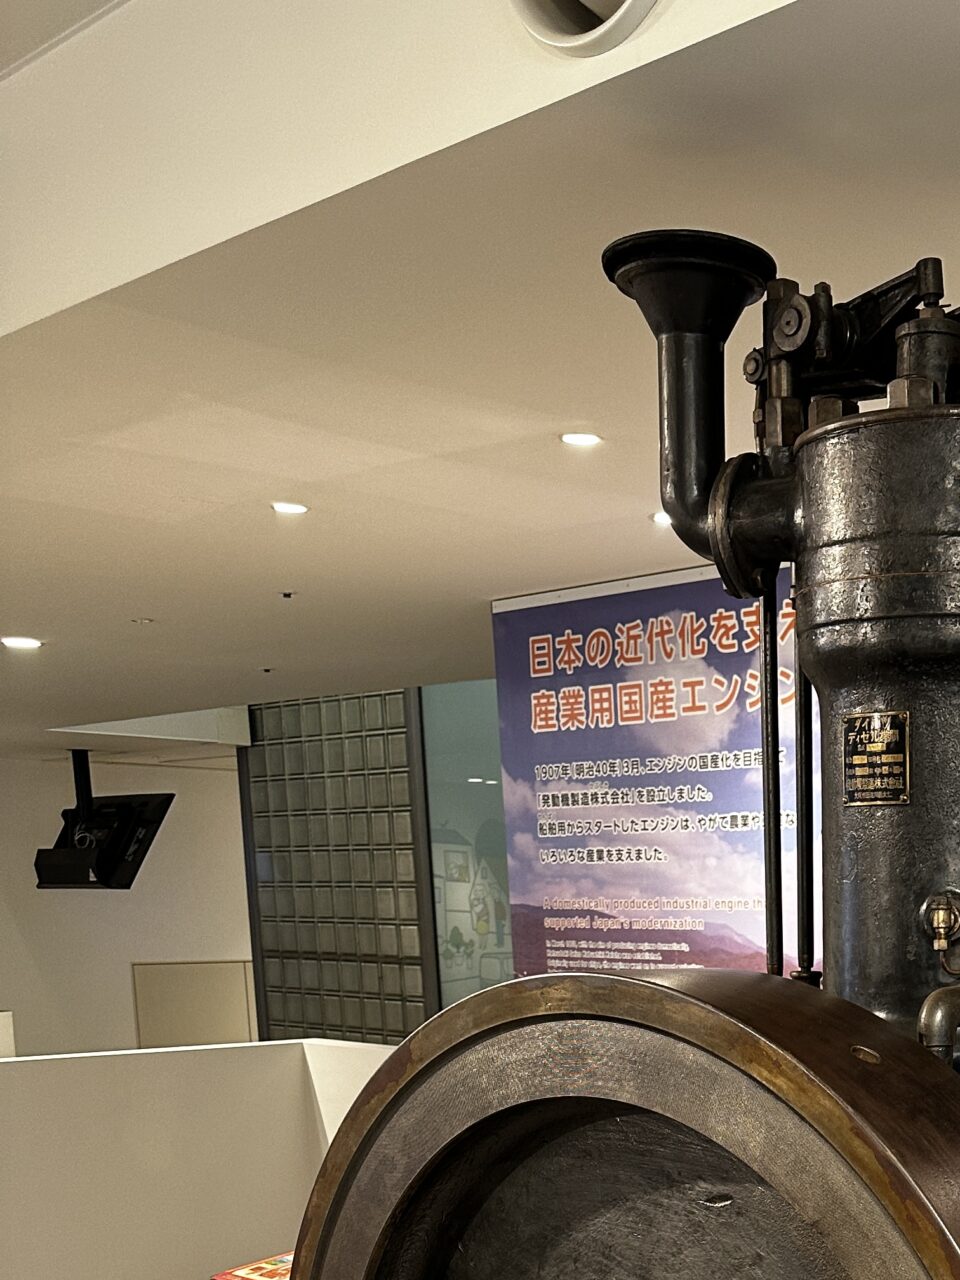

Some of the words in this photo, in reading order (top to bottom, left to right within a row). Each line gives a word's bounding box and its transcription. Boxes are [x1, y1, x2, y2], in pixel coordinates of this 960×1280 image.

[540, 847, 669, 864] いろいろな産業を支えました。
[543, 897, 551, 909] A
[553, 896, 610, 913] domestically
[614, 897, 659, 914] produced
[661, 896, 711, 911] industrial
[714, 897, 750, 913] engine
[543, 916, 590, 931] supported
[592, 916, 630, 932] Japan's
[631, 916, 705, 931] modernization
